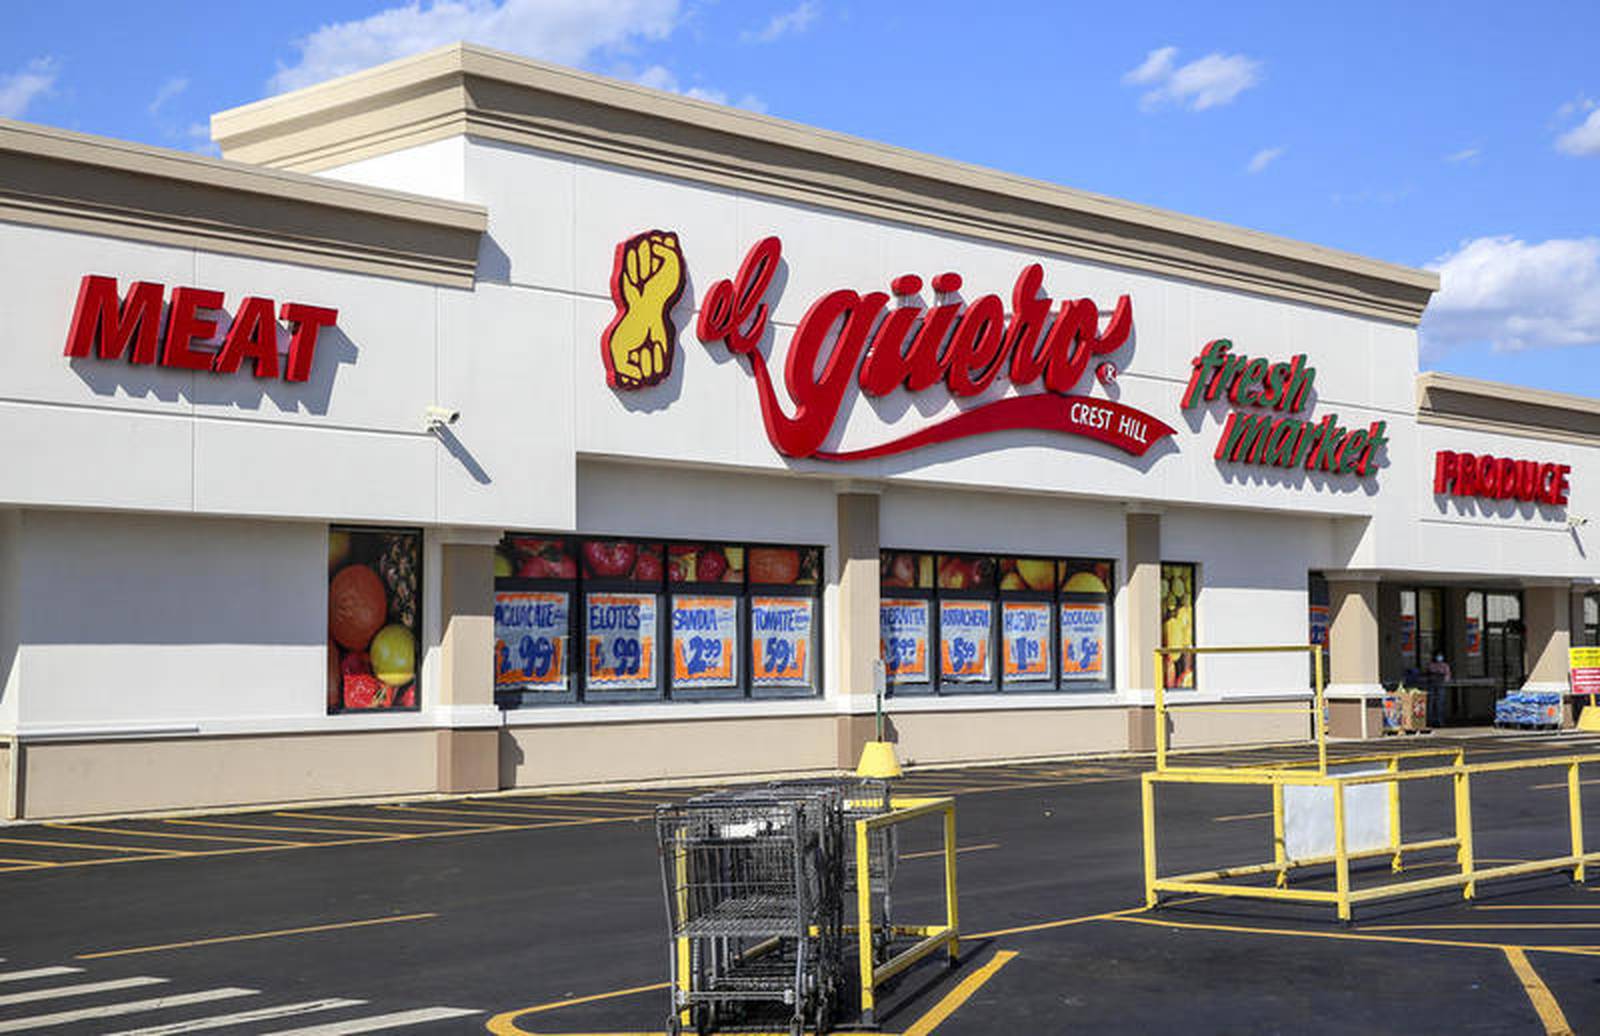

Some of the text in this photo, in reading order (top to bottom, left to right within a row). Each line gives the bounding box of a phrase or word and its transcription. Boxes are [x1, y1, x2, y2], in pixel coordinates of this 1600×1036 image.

[697, 236, 783, 354] el
[64, 274, 339, 383] MEAT
[1180, 338, 1317, 413] fresh
[1071, 402, 1148, 443] CREST HILL
[1214, 412, 1389, 477] market
[1433, 450, 1571, 506] PRODUCE
[590, 605, 641, 630] ELOTES
[752, 606, 795, 632] TOMATE
